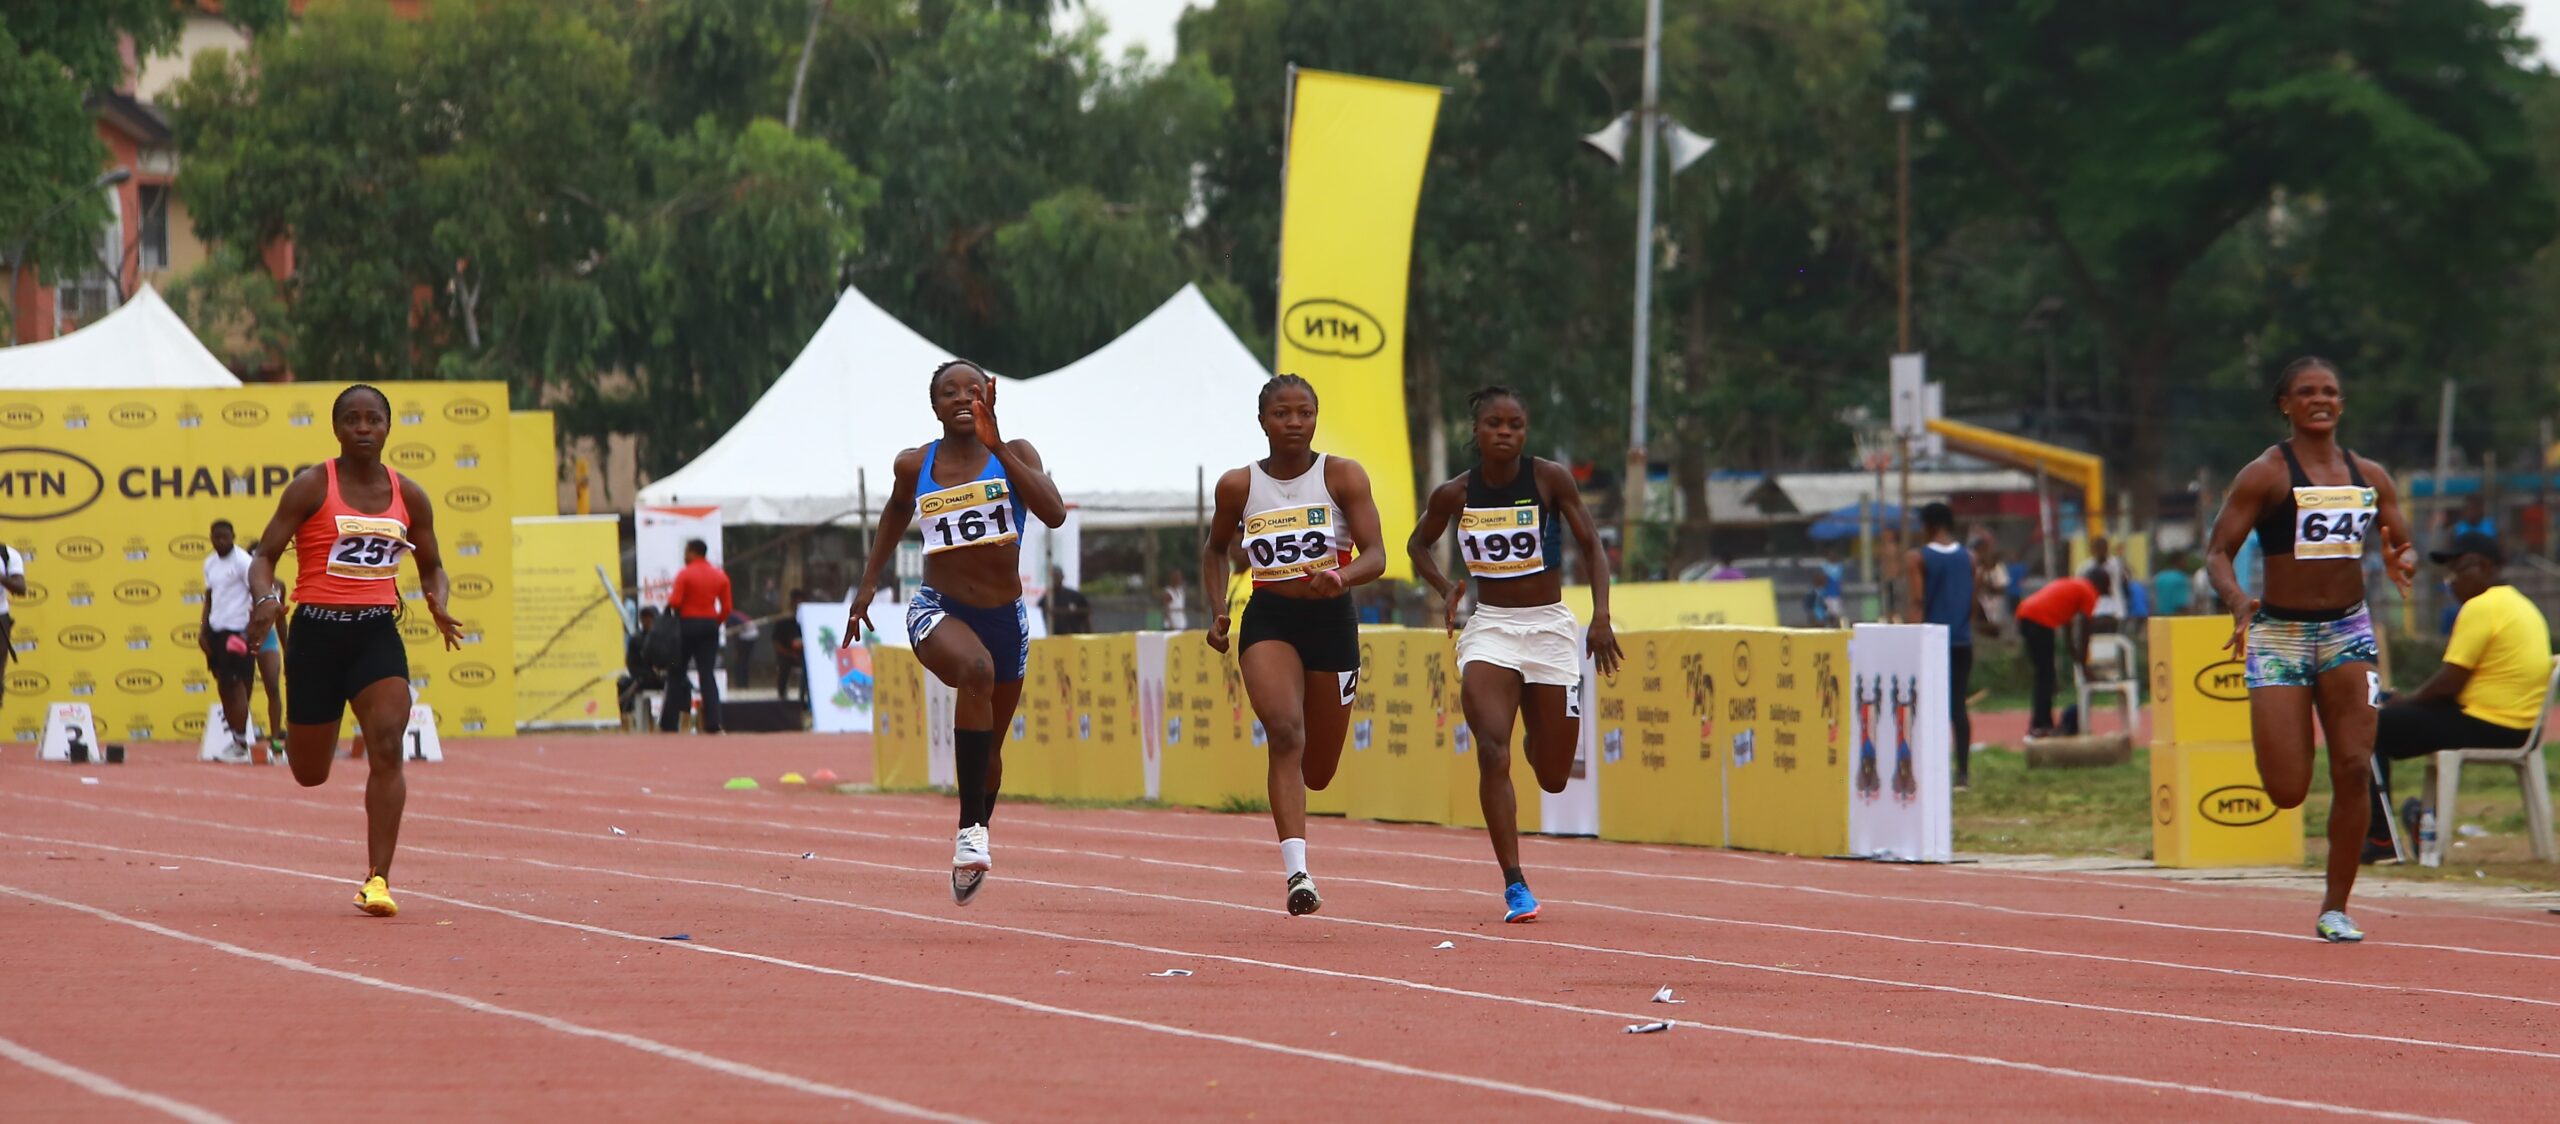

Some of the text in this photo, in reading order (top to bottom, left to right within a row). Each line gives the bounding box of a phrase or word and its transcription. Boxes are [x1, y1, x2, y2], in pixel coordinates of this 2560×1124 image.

[925, 501, 939, 509] MTN
[945, 493, 974, 504] CHAMPS
[935, 504, 1008, 546] 161
[1267, 517, 1297, 526] CHAMPS
[336, 537, 406, 565] 257
[1250, 531, 1328, 567] 053
[1464, 532, 1536, 561] 199
[303, 605, 352, 621] NIKE
[2214, 674, 2246, 688] MT
[408, 729, 427, 760] 1
[2218, 798, 2260, 813] MTN
